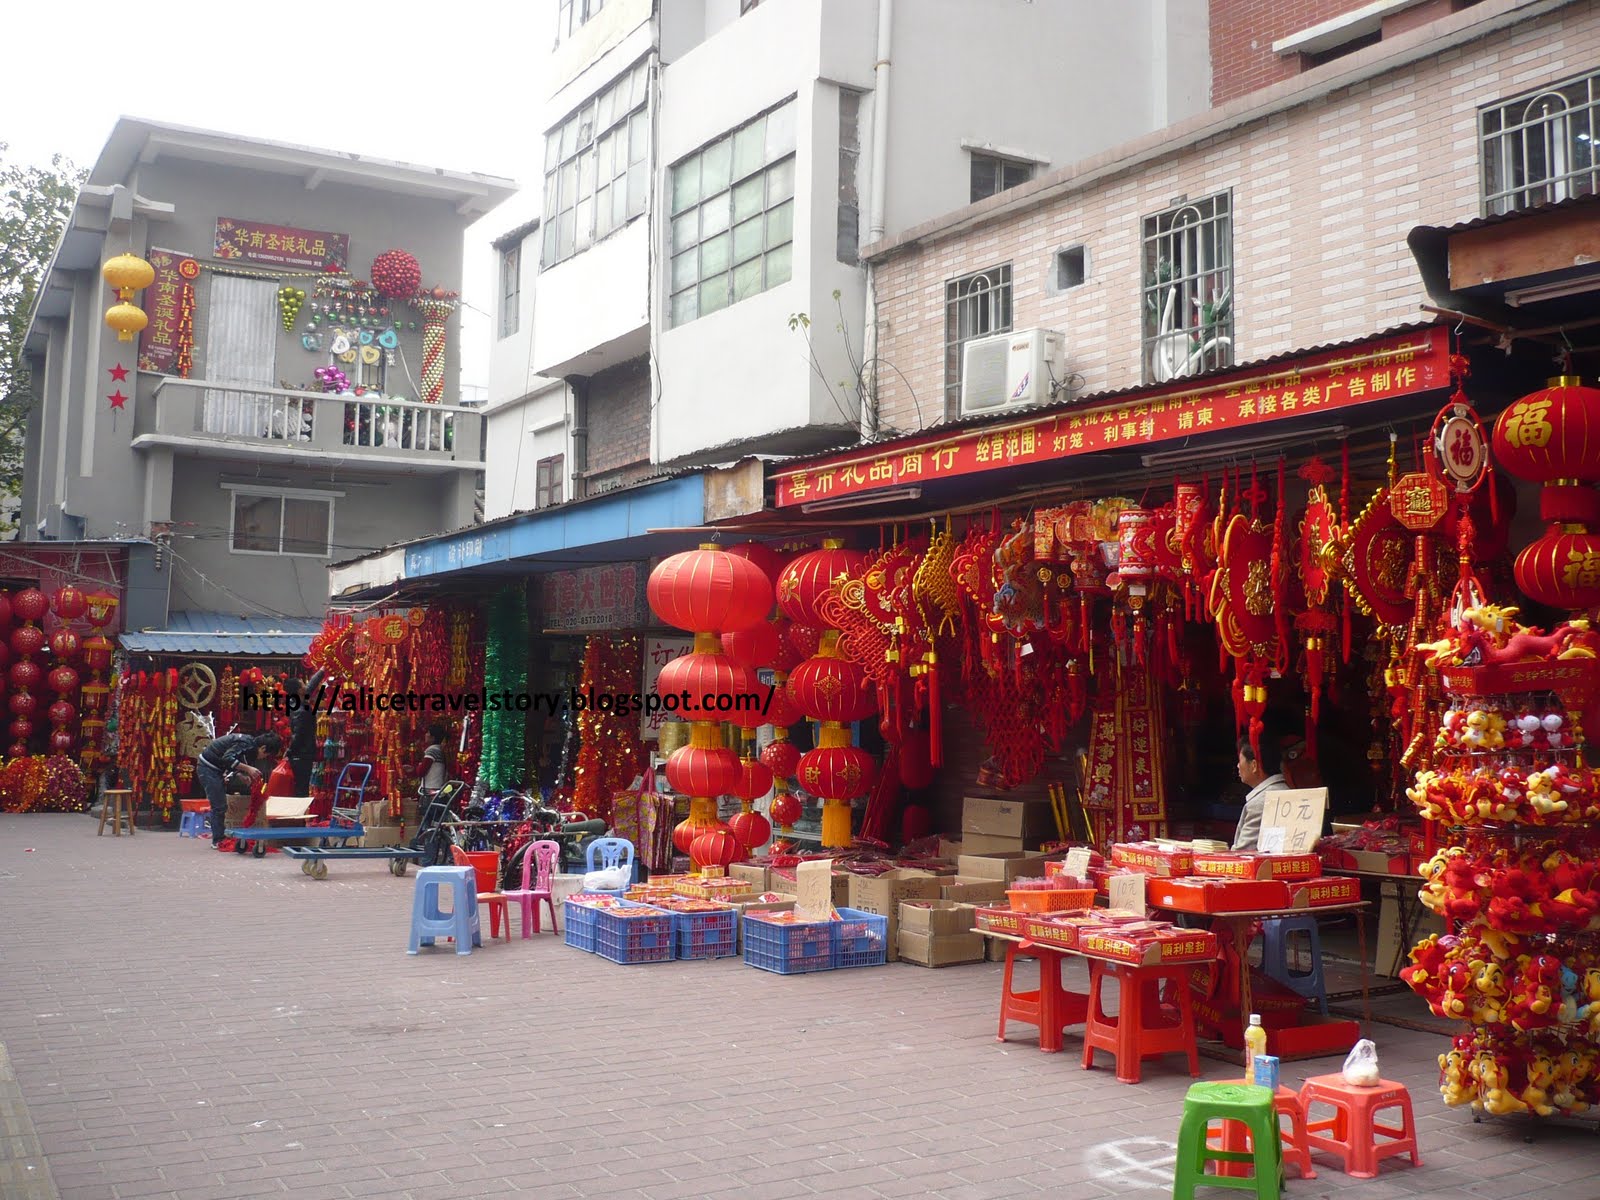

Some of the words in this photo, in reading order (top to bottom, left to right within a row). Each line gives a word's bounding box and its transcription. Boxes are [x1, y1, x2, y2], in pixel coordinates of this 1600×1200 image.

[235, 228, 326, 256] 华南圣诞礼品
[152, 269, 179, 345] 华南圣诞礼品
[1504, 400, 1553, 449] 福
[1451, 429, 1474, 467] 福
[384, 620, 403, 638] 福
